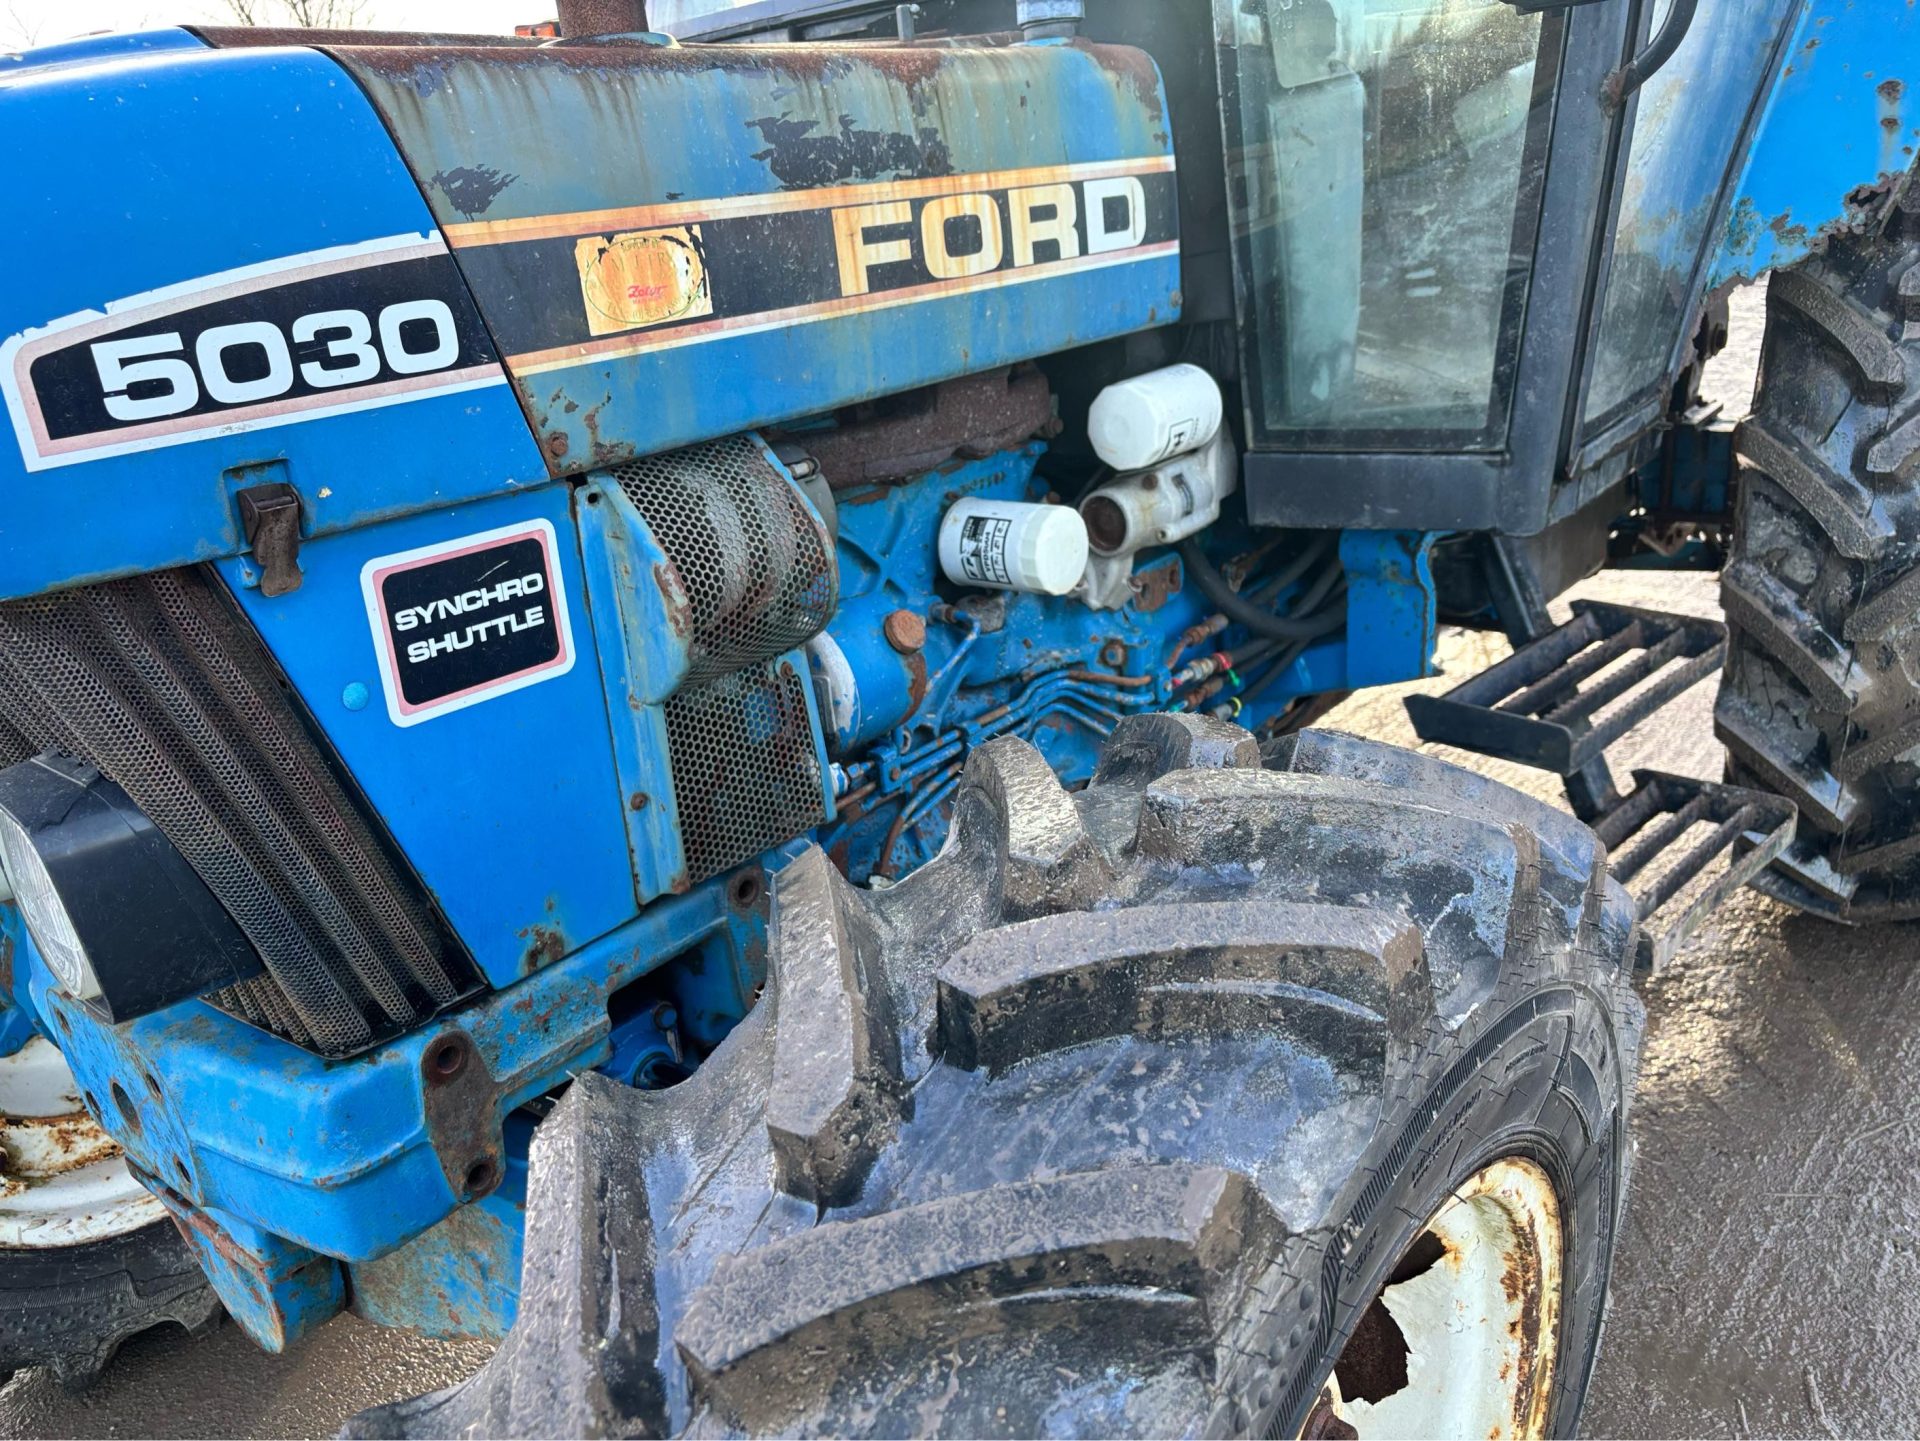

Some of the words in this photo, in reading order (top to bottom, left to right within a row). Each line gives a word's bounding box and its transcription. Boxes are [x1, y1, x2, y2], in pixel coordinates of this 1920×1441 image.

[830, 176, 1147, 298] FORD
[90, 298, 460, 422] 5030
[395, 571, 544, 632] SYNCHRO
[407, 606, 545, 664] SHUTTLE
